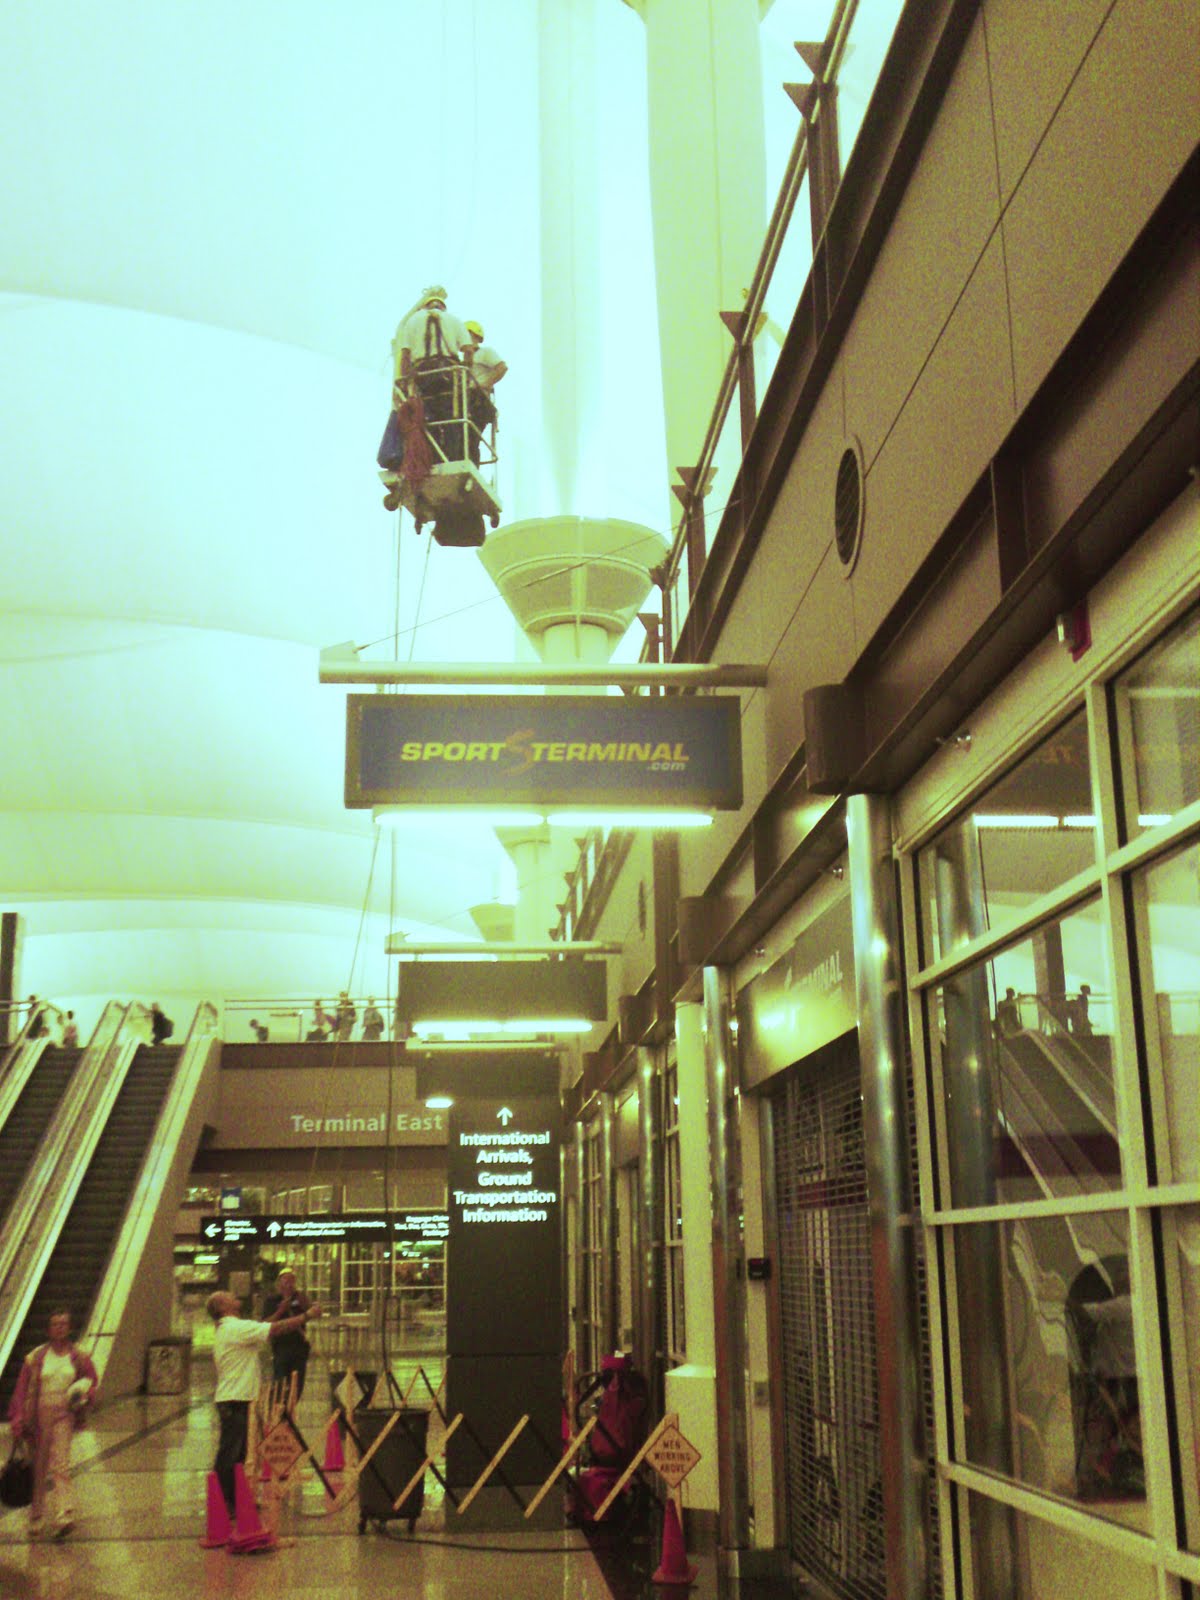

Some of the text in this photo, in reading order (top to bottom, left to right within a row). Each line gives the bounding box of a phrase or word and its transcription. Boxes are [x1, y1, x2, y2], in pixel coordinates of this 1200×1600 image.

[400, 741, 507, 763] SPORT
[290, 1113, 444, 1133] Terminal East
[460, 1130, 550, 1146] International
[476, 1148, 534, 1165] Arrivals,
[477, 1171, 533, 1187] Ground
[452, 1189, 557, 1208] Transportation
[462, 1207, 548, 1223] Information
[662, 1440, 681, 1450] MEN
[654, 1451, 692, 1462] WORKING
